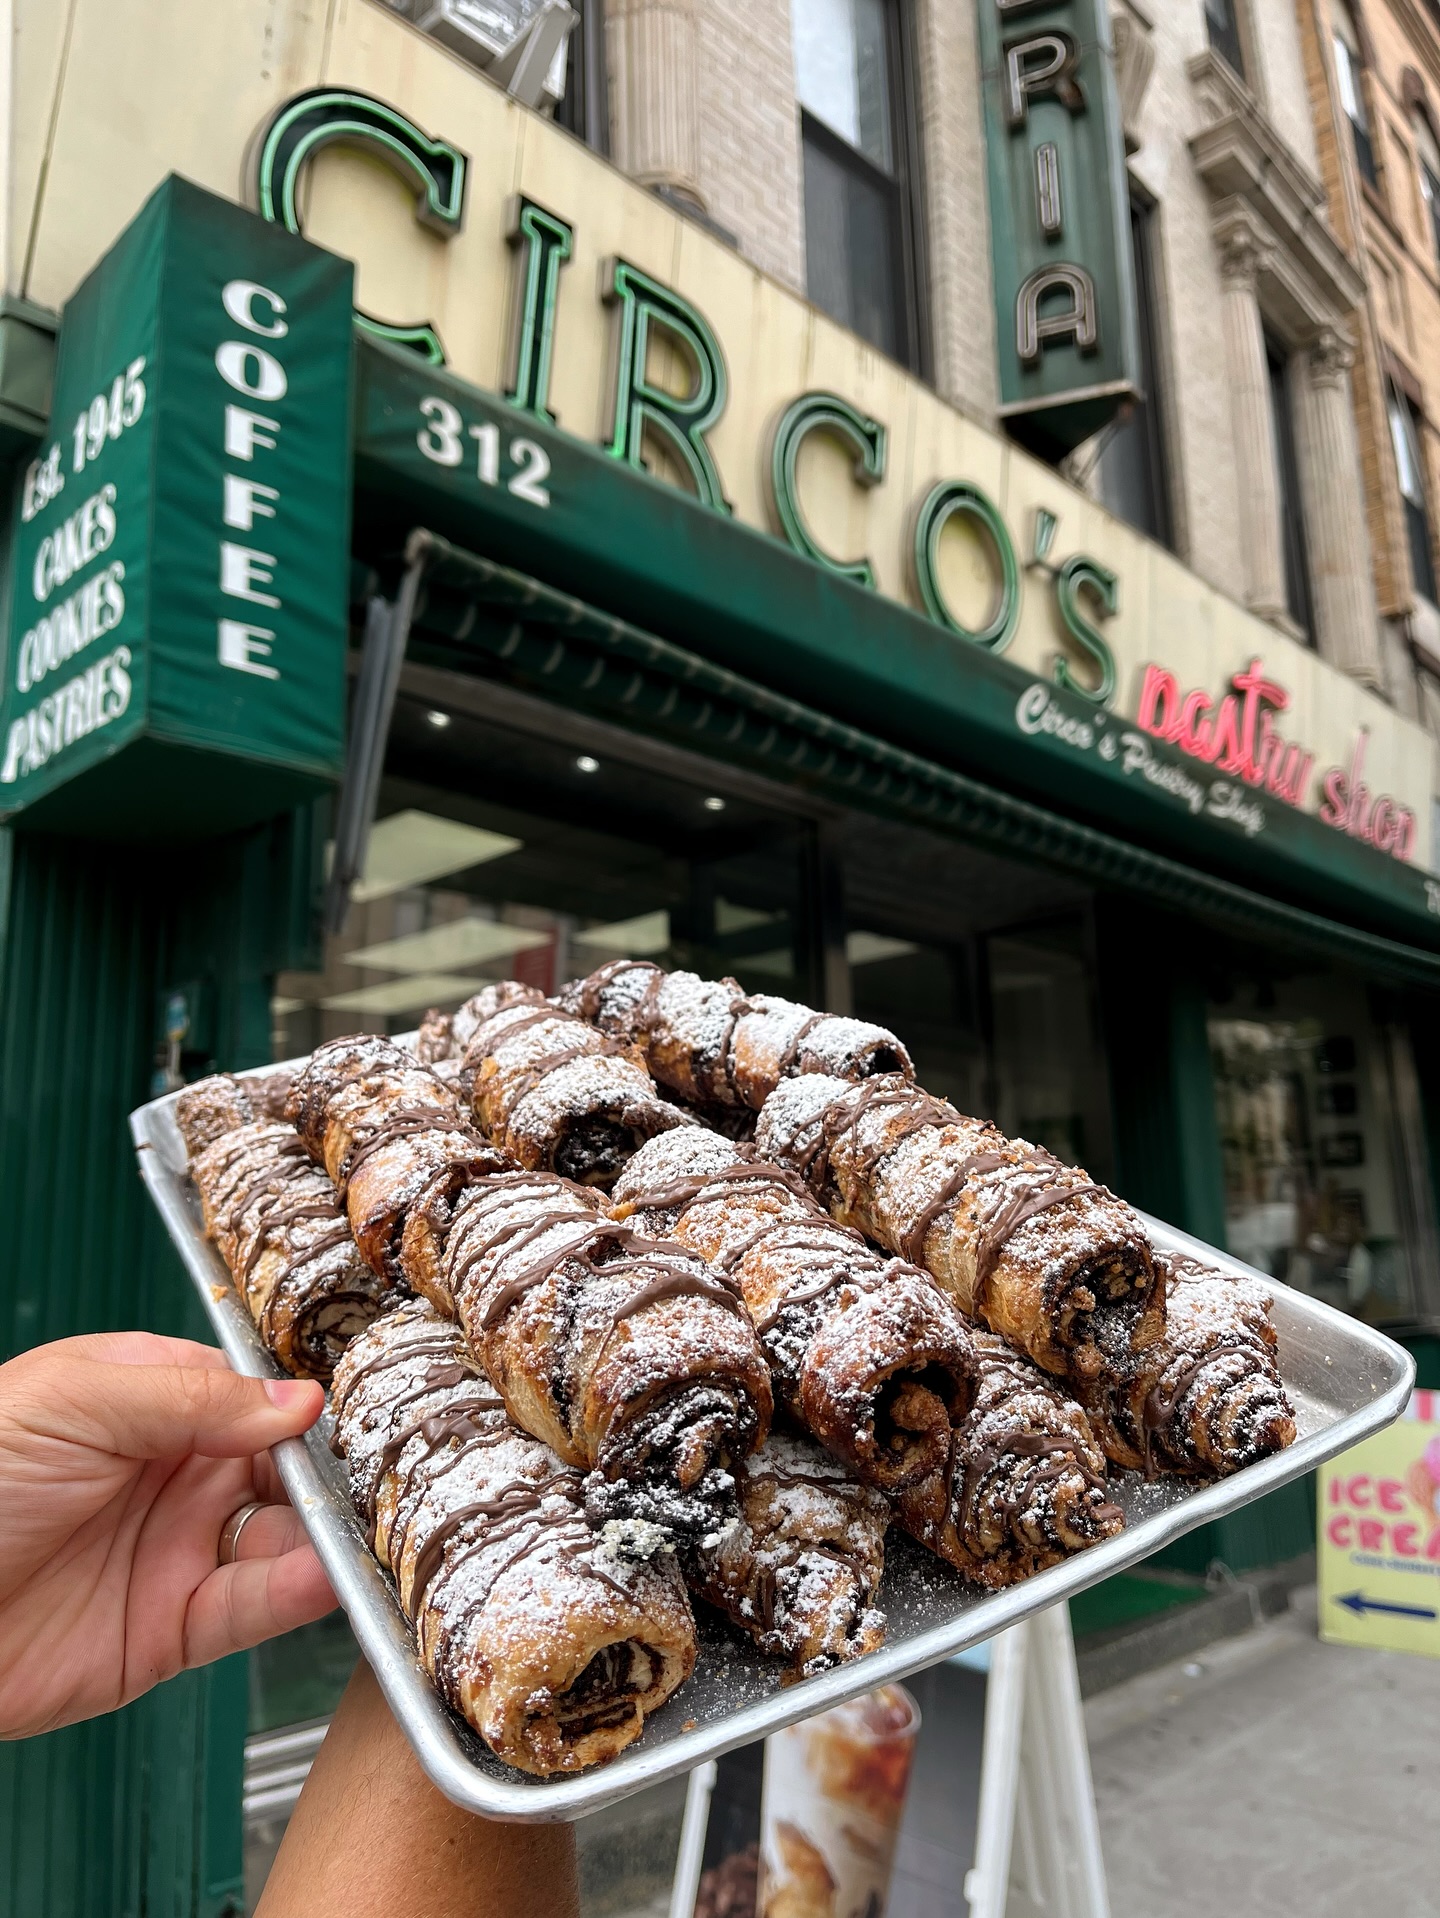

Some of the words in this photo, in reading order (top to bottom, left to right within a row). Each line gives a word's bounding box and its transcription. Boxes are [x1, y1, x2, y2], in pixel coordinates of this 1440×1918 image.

[73, 354, 147, 474] 1945
[256, 87, 1119, 704] CIRCO'S
[416, 397, 553, 509] 312
[32, 482, 117, 602] CAKES
[214, 278, 289, 681] COFFEE
[16, 560, 126, 694] COOKIES
[0, 645, 132, 784] PASTRIES
[1015, 683, 1118, 762] Circo's
[1120, 731, 1206, 816] Pastry
[1206, 780, 1266, 838] Shop
[1329, 1474, 1404, 1513] ICE
